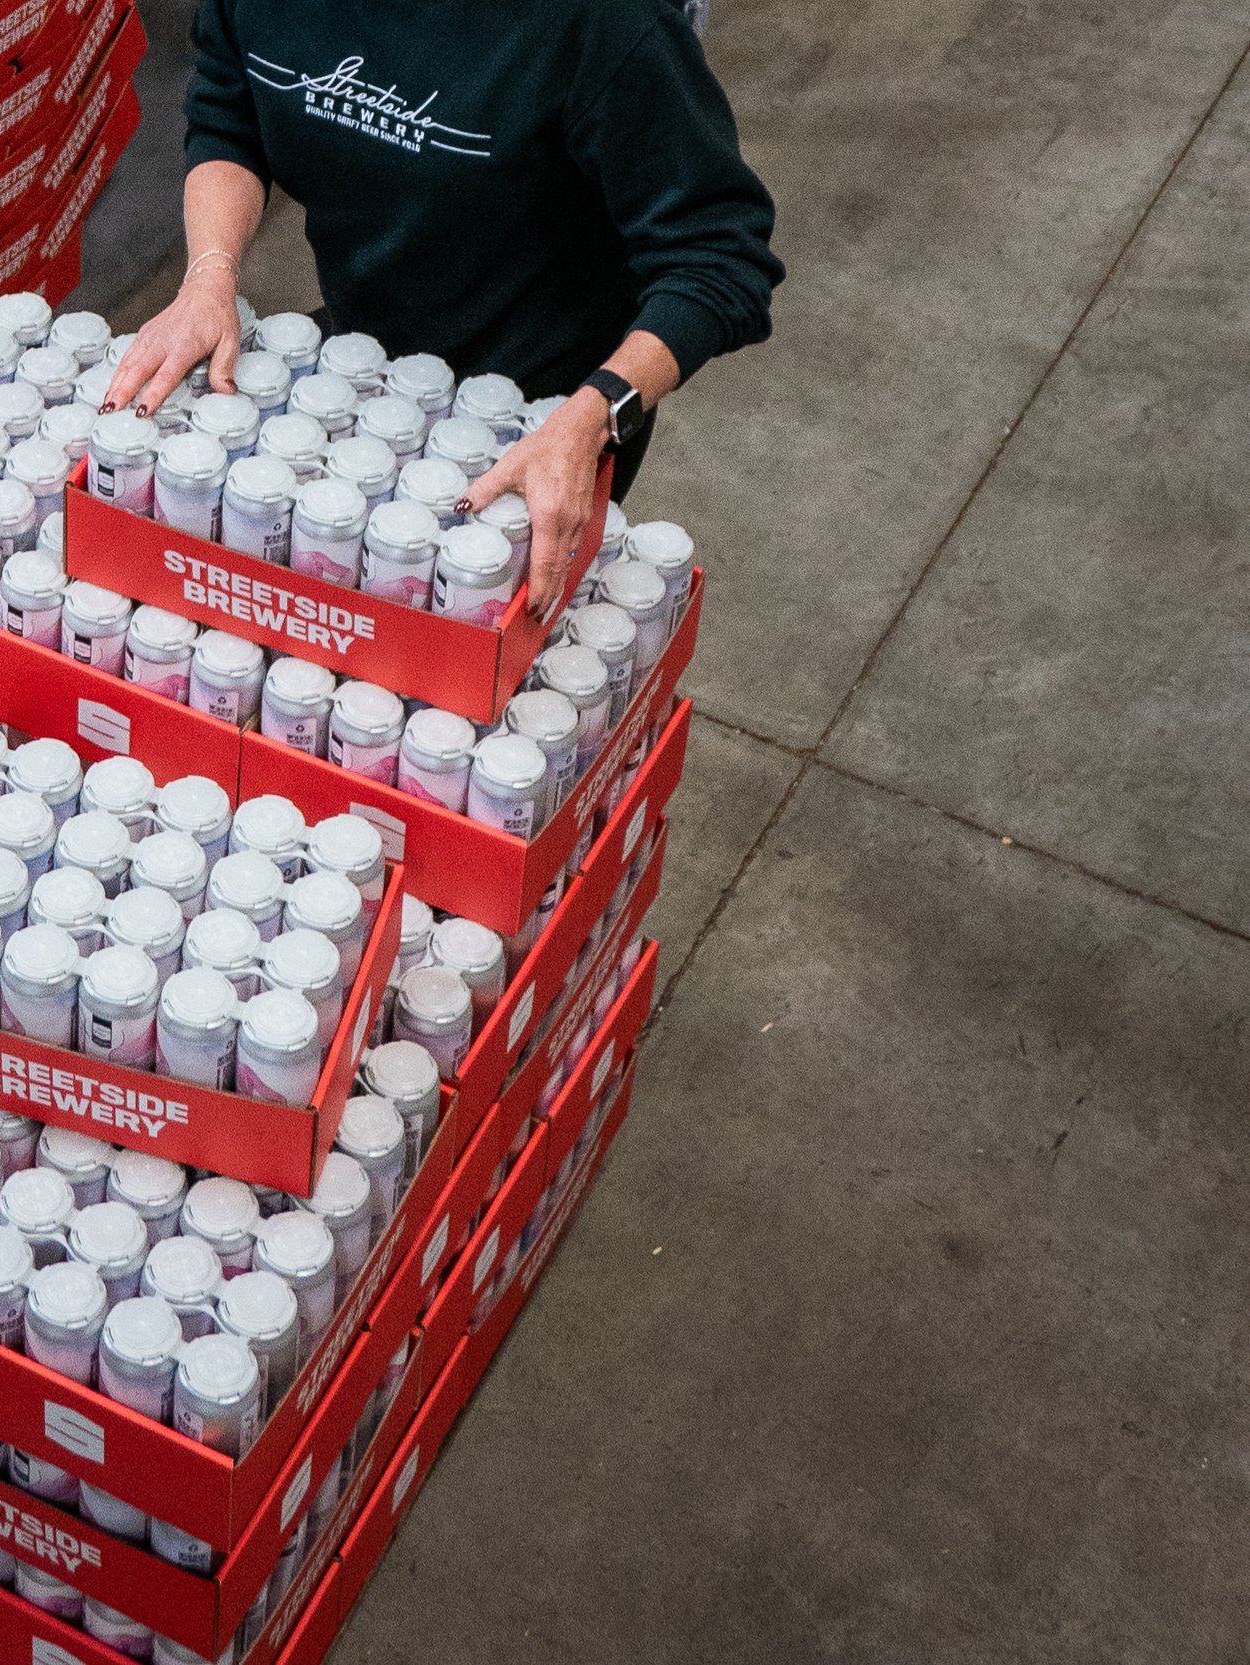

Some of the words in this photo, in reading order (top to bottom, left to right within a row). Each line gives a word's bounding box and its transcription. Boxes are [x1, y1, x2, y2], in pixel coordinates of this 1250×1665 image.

[305, 91, 425, 143] BREWERY
[164, 550, 375, 640] STREETSIDE
[183, 579, 355, 655] BREWERY
